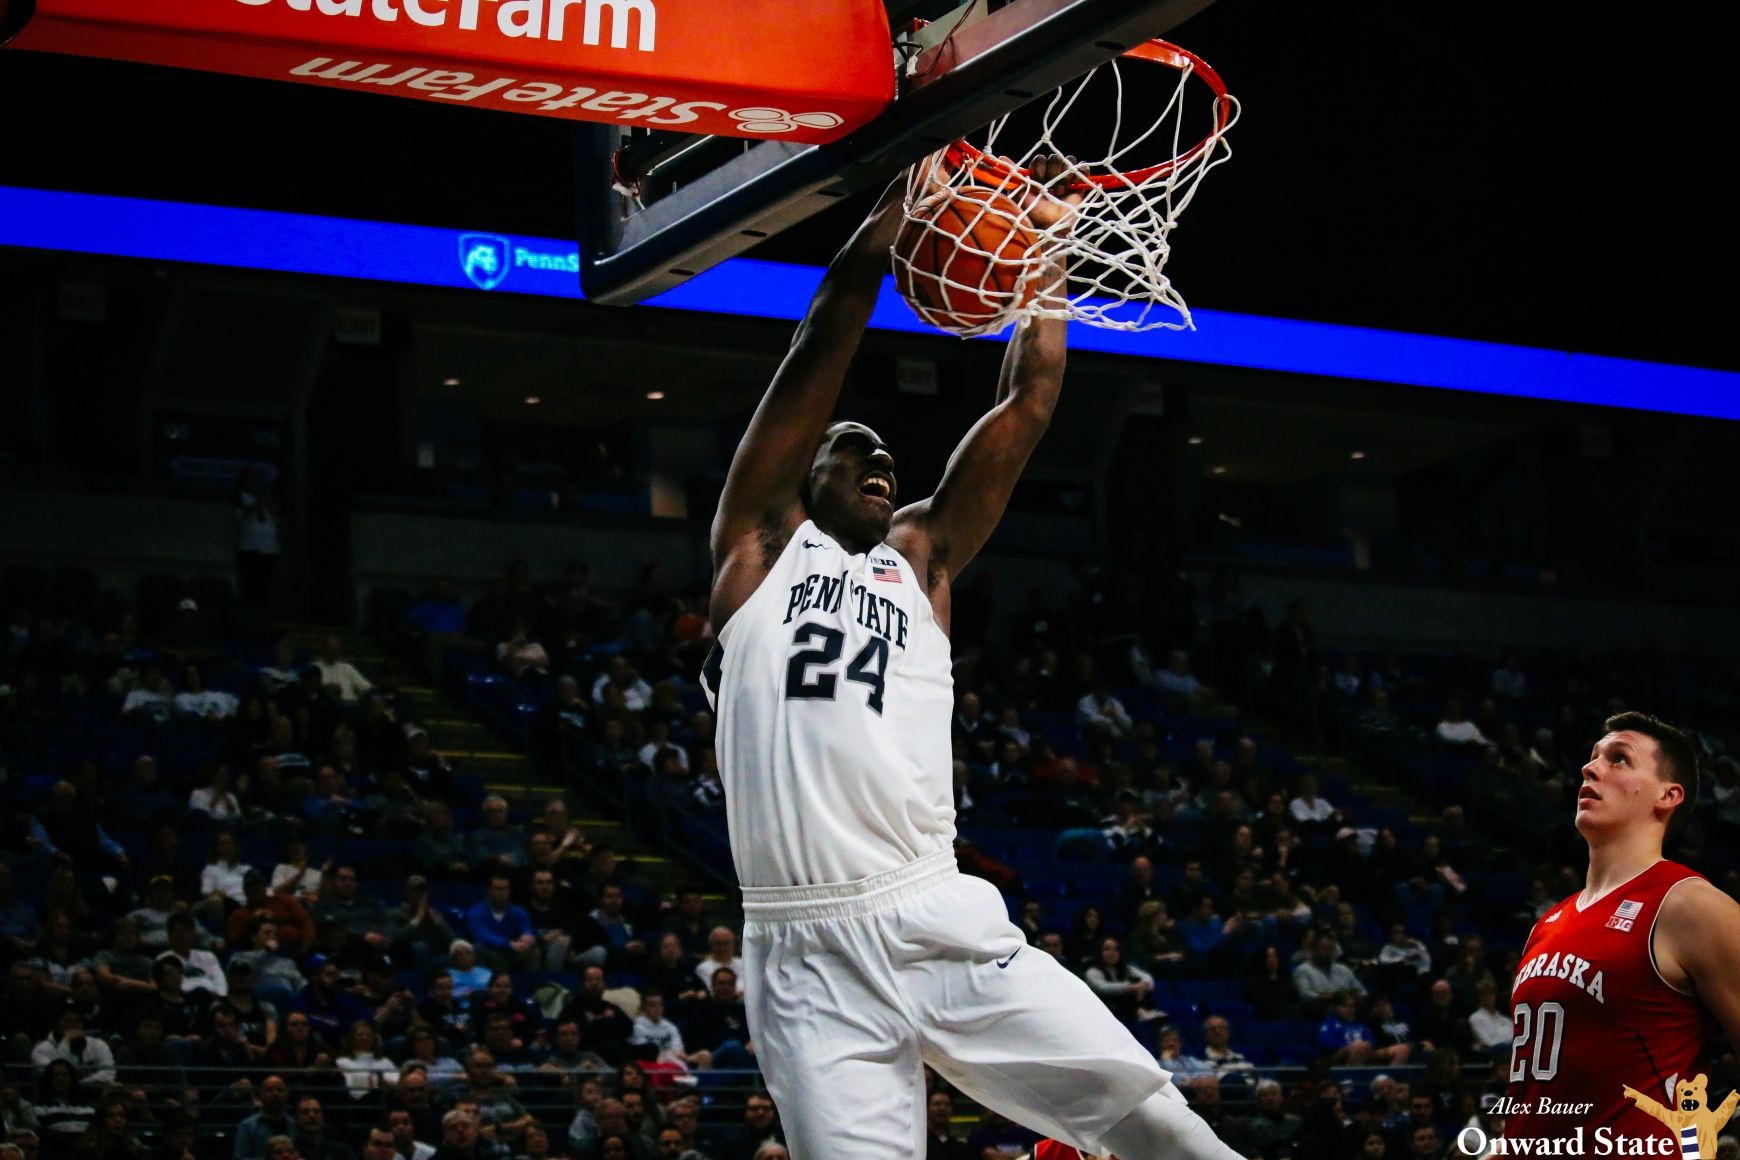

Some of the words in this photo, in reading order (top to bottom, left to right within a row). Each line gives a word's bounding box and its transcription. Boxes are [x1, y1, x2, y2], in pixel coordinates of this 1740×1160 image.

[289, 56, 728, 126] StateFarm
[784, 621, 890, 719] 24
[1510, 1002, 1565, 1083] 20
